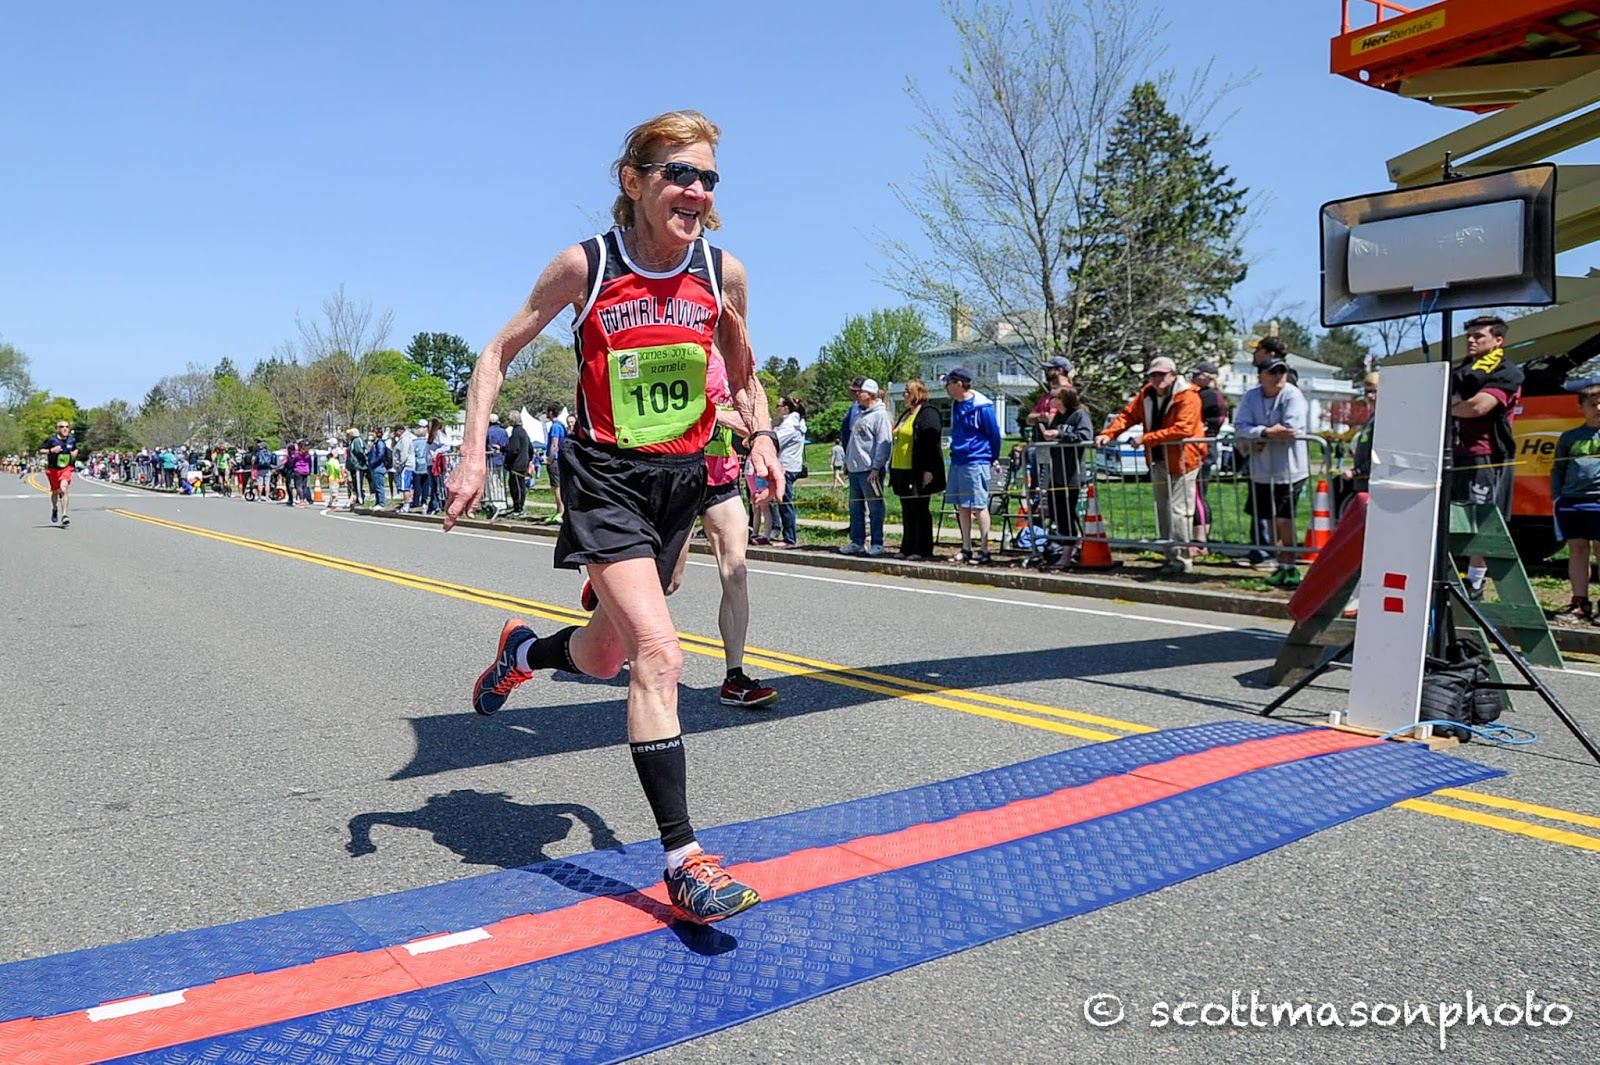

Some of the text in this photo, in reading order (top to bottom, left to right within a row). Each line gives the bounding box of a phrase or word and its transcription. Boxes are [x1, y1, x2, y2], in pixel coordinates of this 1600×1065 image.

[597, 297, 712, 336] WHIRLAWAY
[671, 346, 698, 359] Joyce
[630, 379, 689, 416] 109
